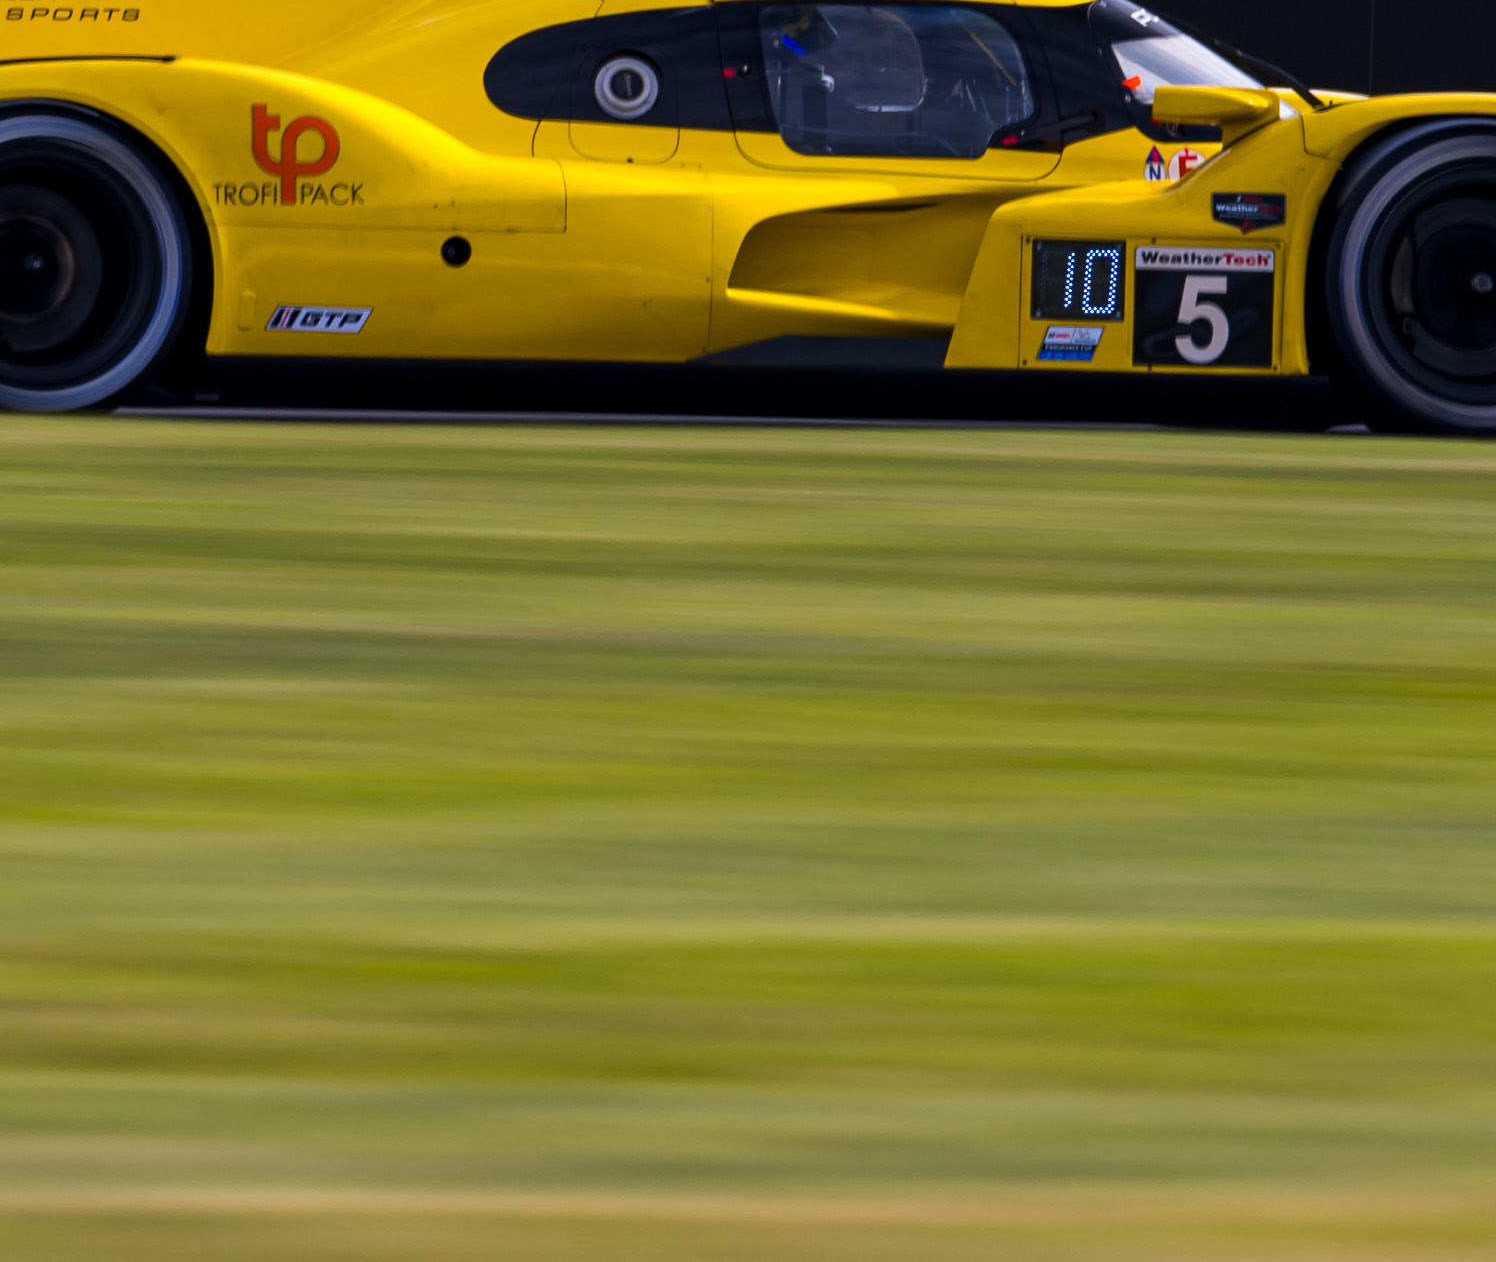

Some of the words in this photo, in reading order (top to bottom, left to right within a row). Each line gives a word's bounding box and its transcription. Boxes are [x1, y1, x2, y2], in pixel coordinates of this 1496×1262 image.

[213, 182, 278, 206] TROFI
[301, 182, 365, 206] PACK
[1141, 250, 1269, 267] WeatherTech
[1064, 249, 1120, 314] 10
[300, 311, 363, 328] GTP
[1175, 274, 1230, 364] 5
